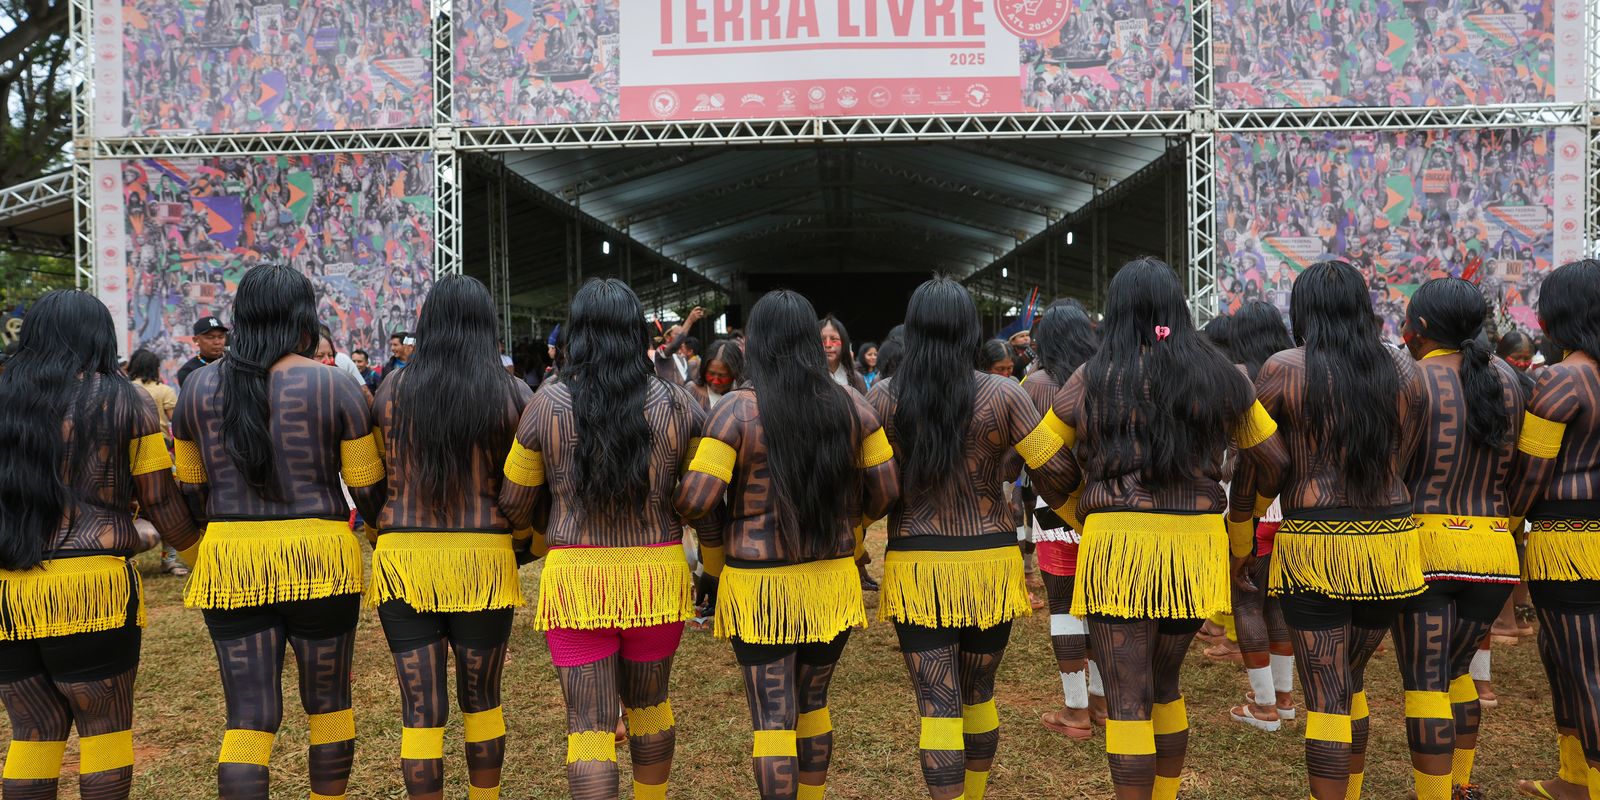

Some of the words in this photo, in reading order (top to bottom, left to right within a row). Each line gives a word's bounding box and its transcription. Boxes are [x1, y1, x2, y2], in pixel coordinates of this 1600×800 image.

[838, 0, 986, 37] LIVRE
[1008, 13, 1024, 28] ATL
[1029, 17, 1053, 31] 2025
[950, 53, 986, 65] 2025
